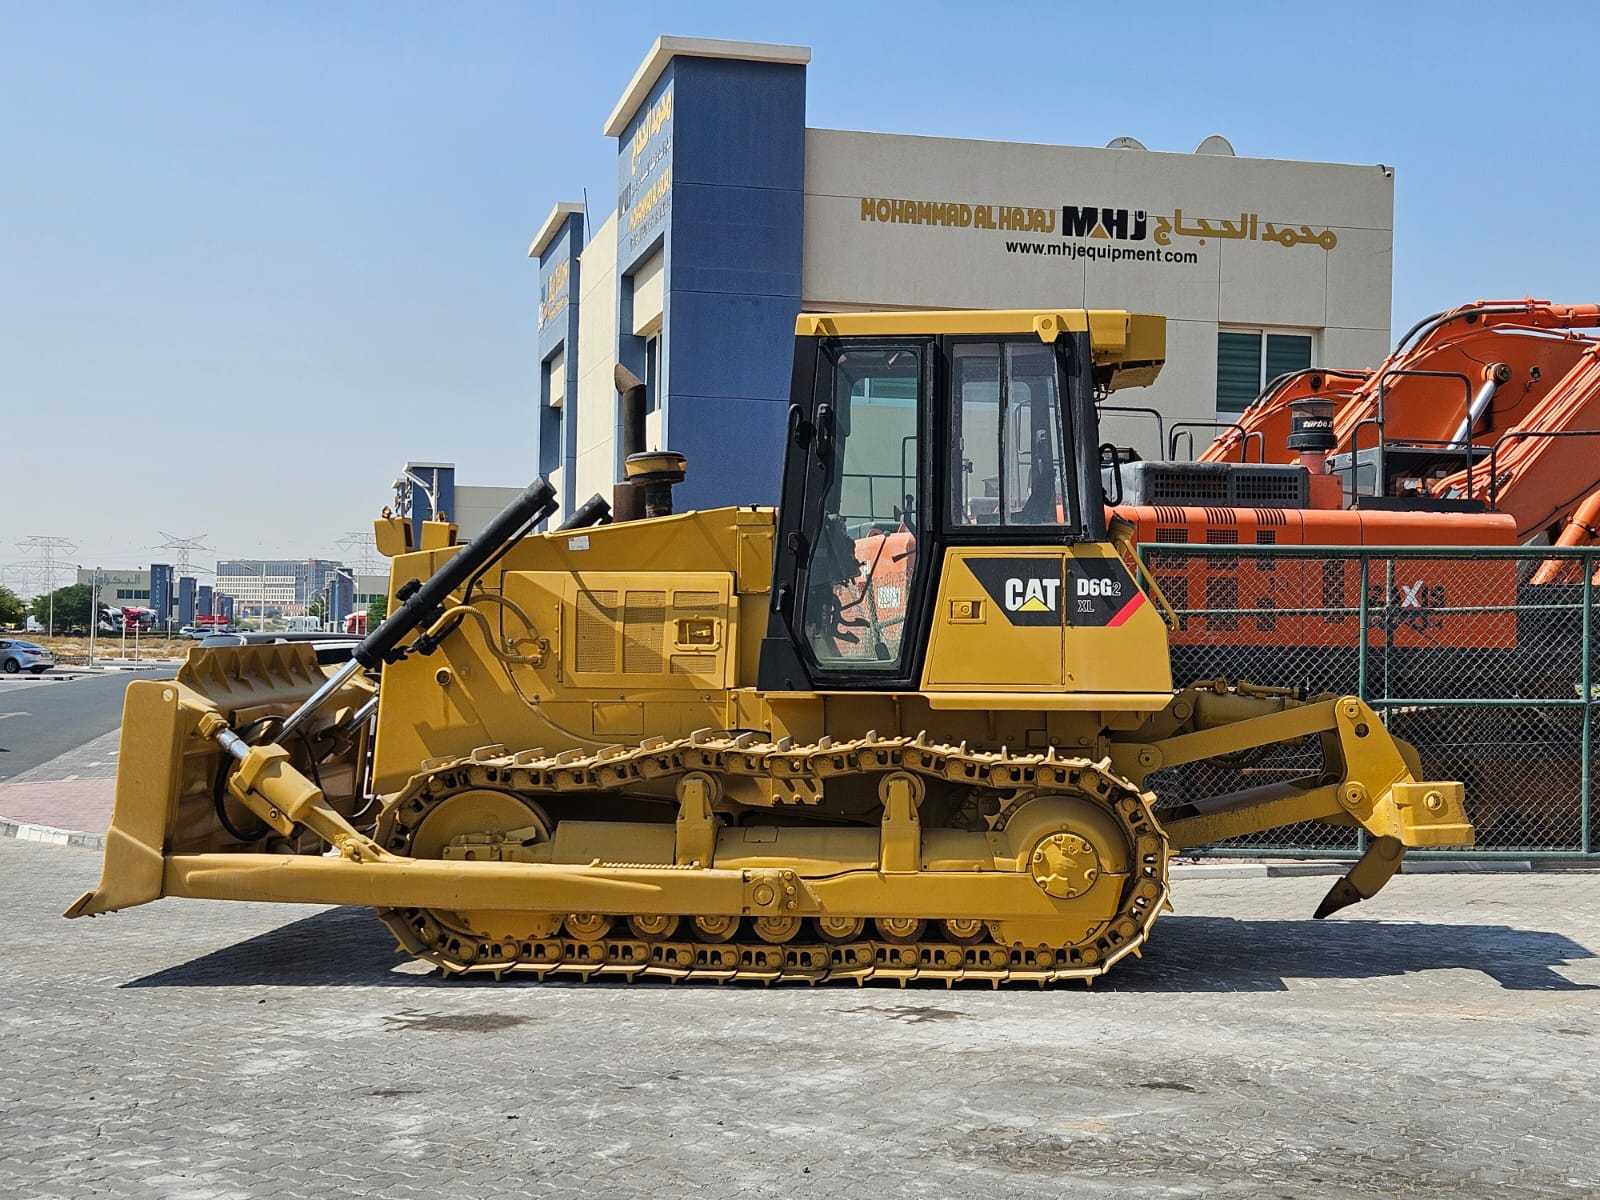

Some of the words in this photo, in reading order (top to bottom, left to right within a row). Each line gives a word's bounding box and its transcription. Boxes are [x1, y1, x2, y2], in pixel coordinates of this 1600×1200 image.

[861, 198, 973, 228] MOHAMMAD
[974, 205, 997, 230] AL
[999, 207, 1056, 233] HAJAJ
[1062, 205, 1147, 241] MHJ
[1153, 208, 1258, 246] الحجاج
[1261, 221, 1338, 250] محمد
[1005, 241, 1198, 263] www.mhjequipment.com
[1005, 578, 1060, 611] CAT
[1077, 578, 1121, 597] D6G2
[1077, 599, 1095, 613] XL
